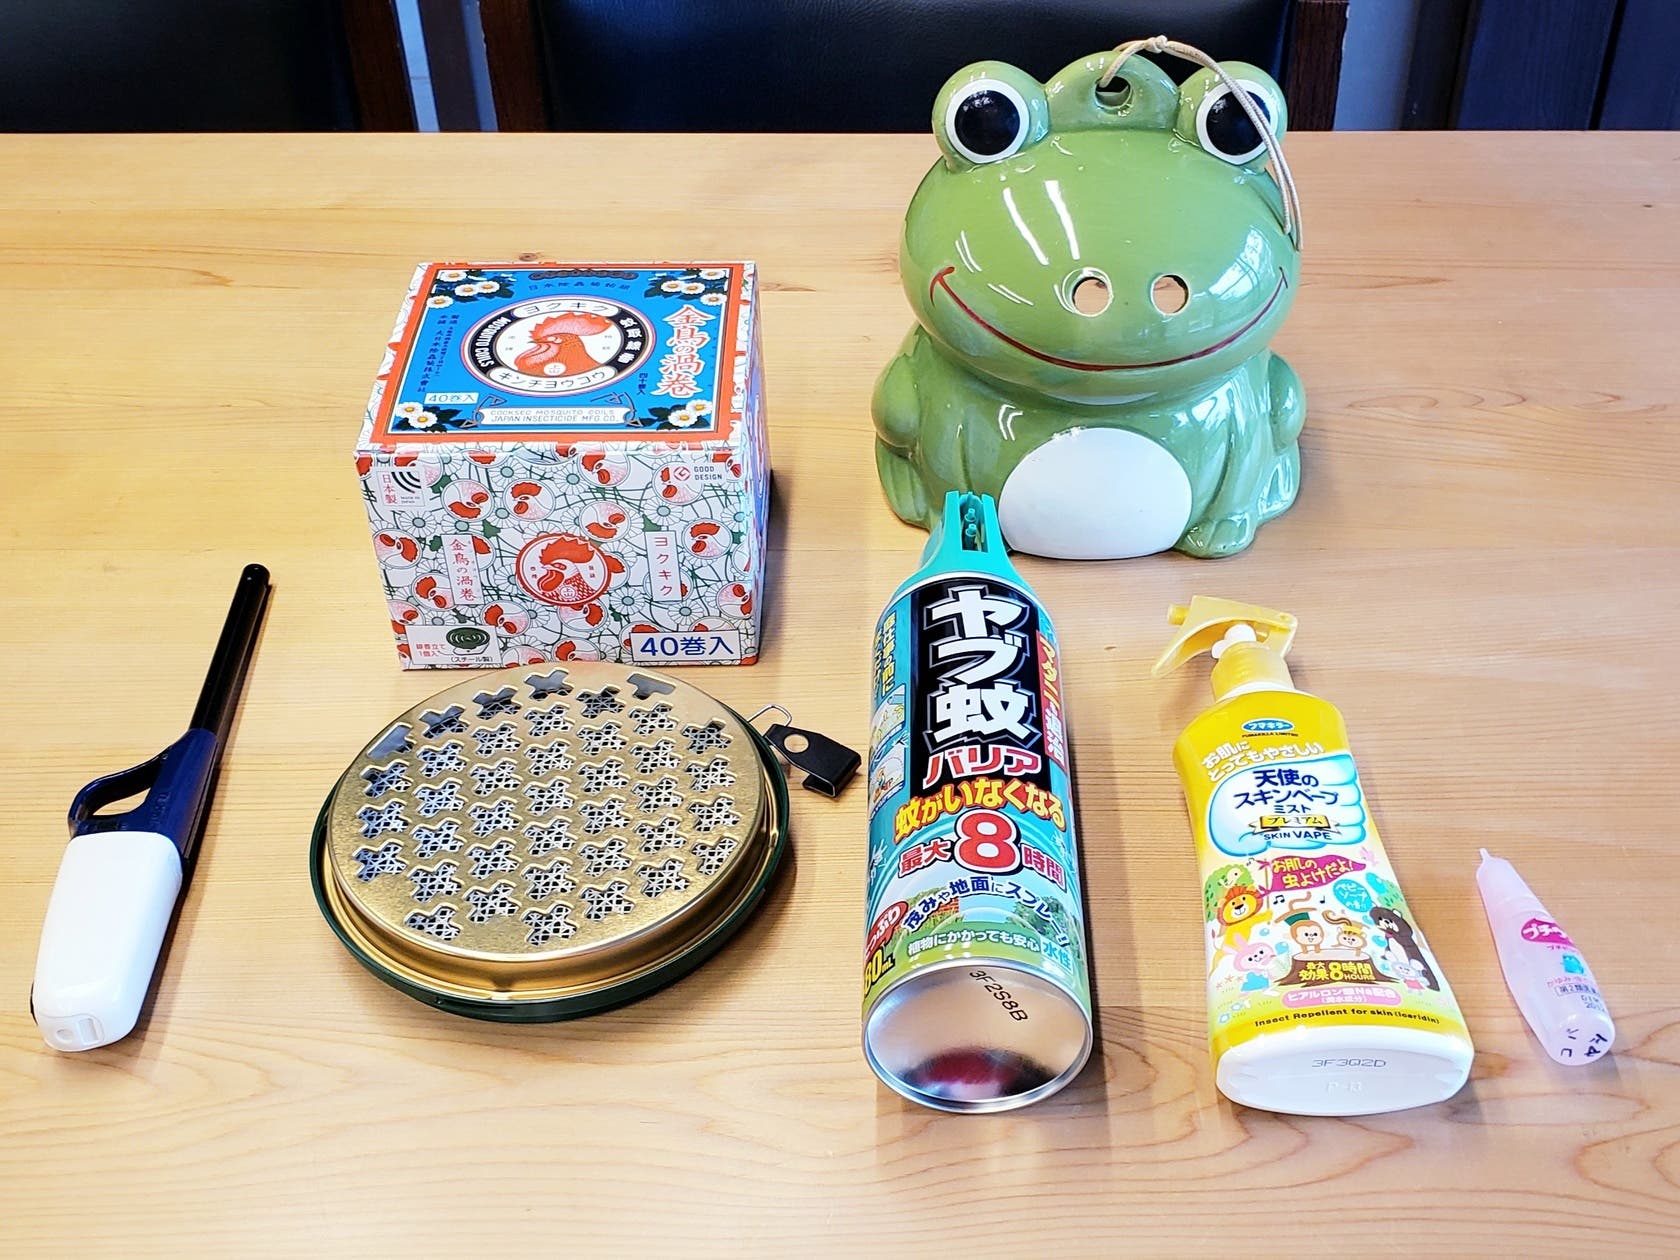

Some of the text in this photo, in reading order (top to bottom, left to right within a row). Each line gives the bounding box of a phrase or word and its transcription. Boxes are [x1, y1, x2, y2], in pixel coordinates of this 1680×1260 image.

[523, 302, 609, 315] ヨクキク
[475, 316, 511, 367] MOSQUITO COILS
[650, 304, 717, 398] 金鳥の渦巻
[491, 415, 521, 423] JAPAN
[382, 474, 398, 504] 日本製
[450, 539, 477, 601] 金鳥の渦巻
[654, 536, 673, 596] ヨクキク
[639, 635, 735, 656] 40巻入
[927, 586, 1040, 748] ヤブ蚊
[1248, 721, 1291, 730] フマキラー
[923, 744, 1042, 789] バリア
[1202, 741, 1251, 769] お肌に
[1208, 742, 1326, 782] とってもやさしい
[1252, 769, 1319, 788] 天使の
[895, 778, 1066, 841] 蚊がいなくなる
[1233, 788, 1339, 809] スキンベープ
[1274, 804, 1312, 813] ミスト
[1263, 830, 1333, 841] SKIN VAPE
[1272, 858, 1317, 873] お肌の
[1282, 859, 1354, 889] 虫よけだよ!
[908, 930, 1041, 956] 植物にかかっても安心
[969, 970, 1028, 1021] 3F2S8B
[1255, 1014, 1290, 1027] Insect
[1293, 1008, 1348, 1020] Repellent
[1370, 1009, 1394, 1017] skin
